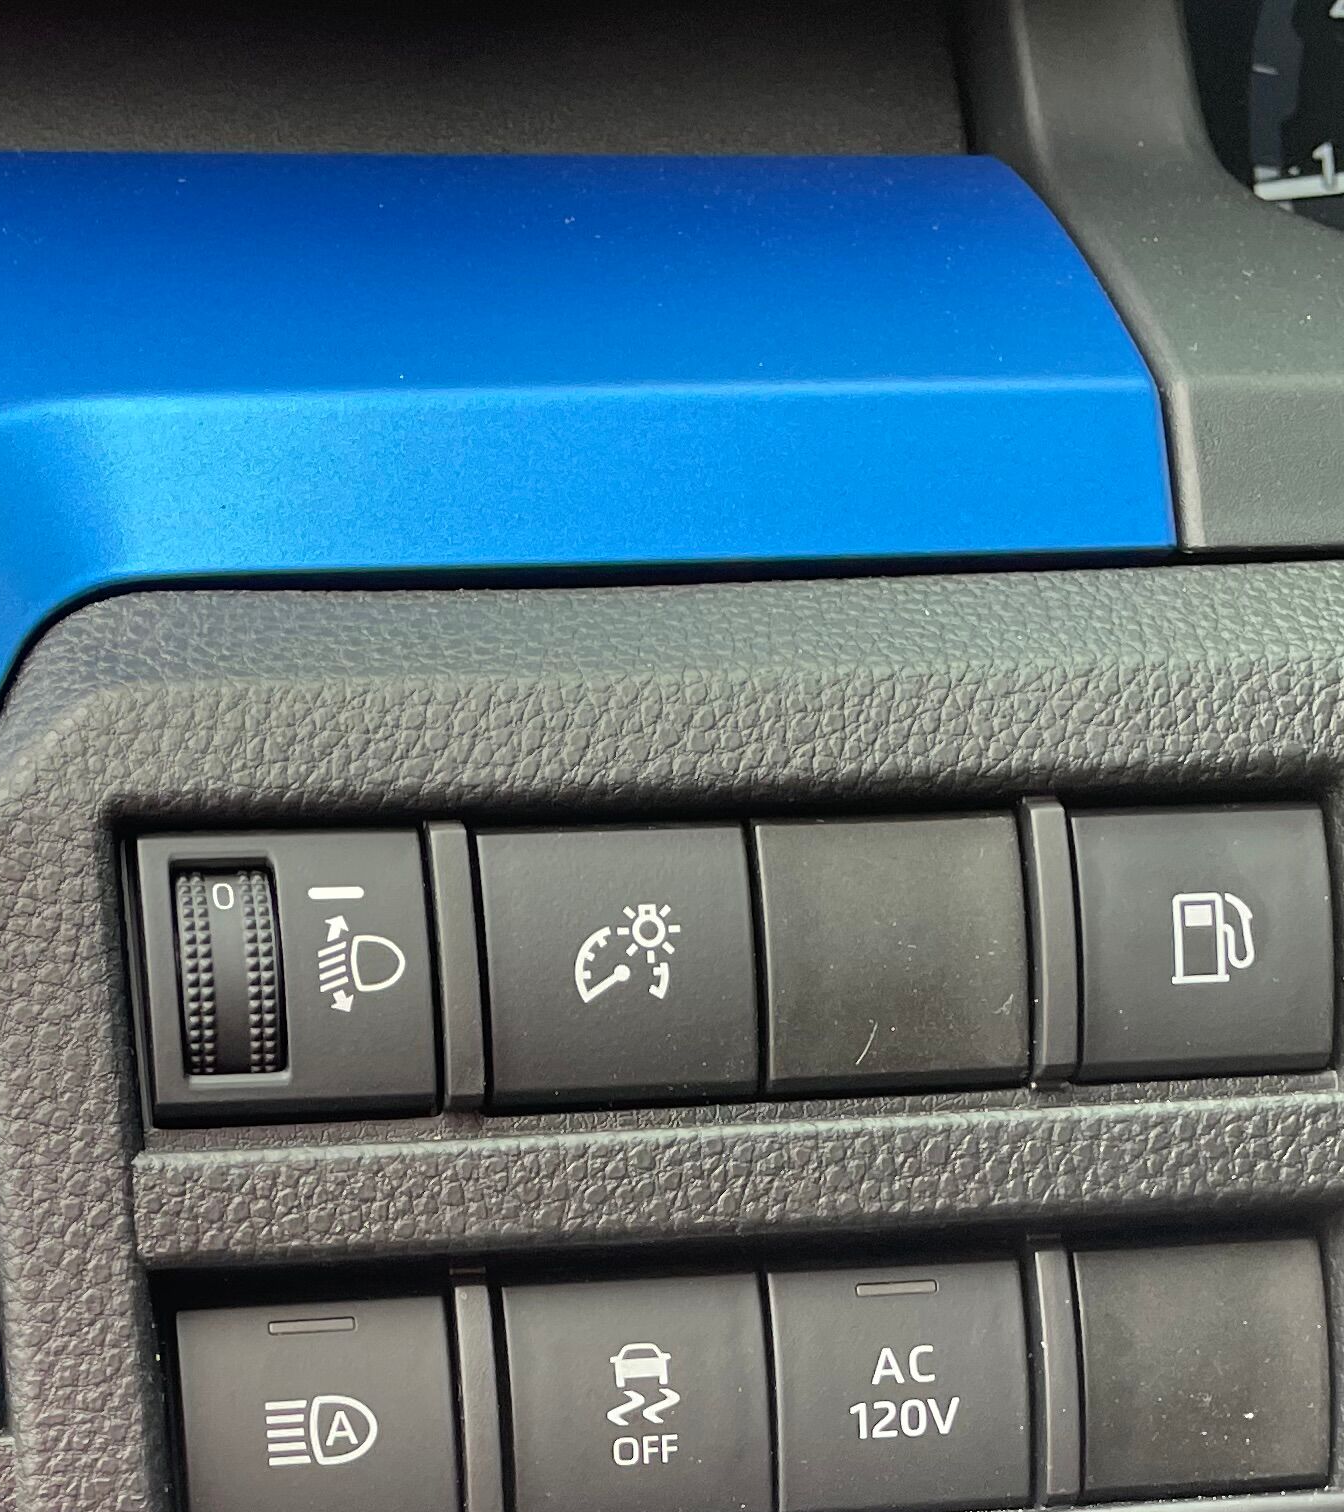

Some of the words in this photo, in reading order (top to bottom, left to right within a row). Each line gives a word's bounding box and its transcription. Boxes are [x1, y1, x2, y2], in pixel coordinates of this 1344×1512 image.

[1311, 142, 1337, 190] 1
[212, 882, 235, 911] 0
[870, 1343, 936, 1385] AC
[325, 1409, 359, 1447] A
[848, 1395, 961, 1441] 120V
[612, 1432, 679, 1467] OFF
